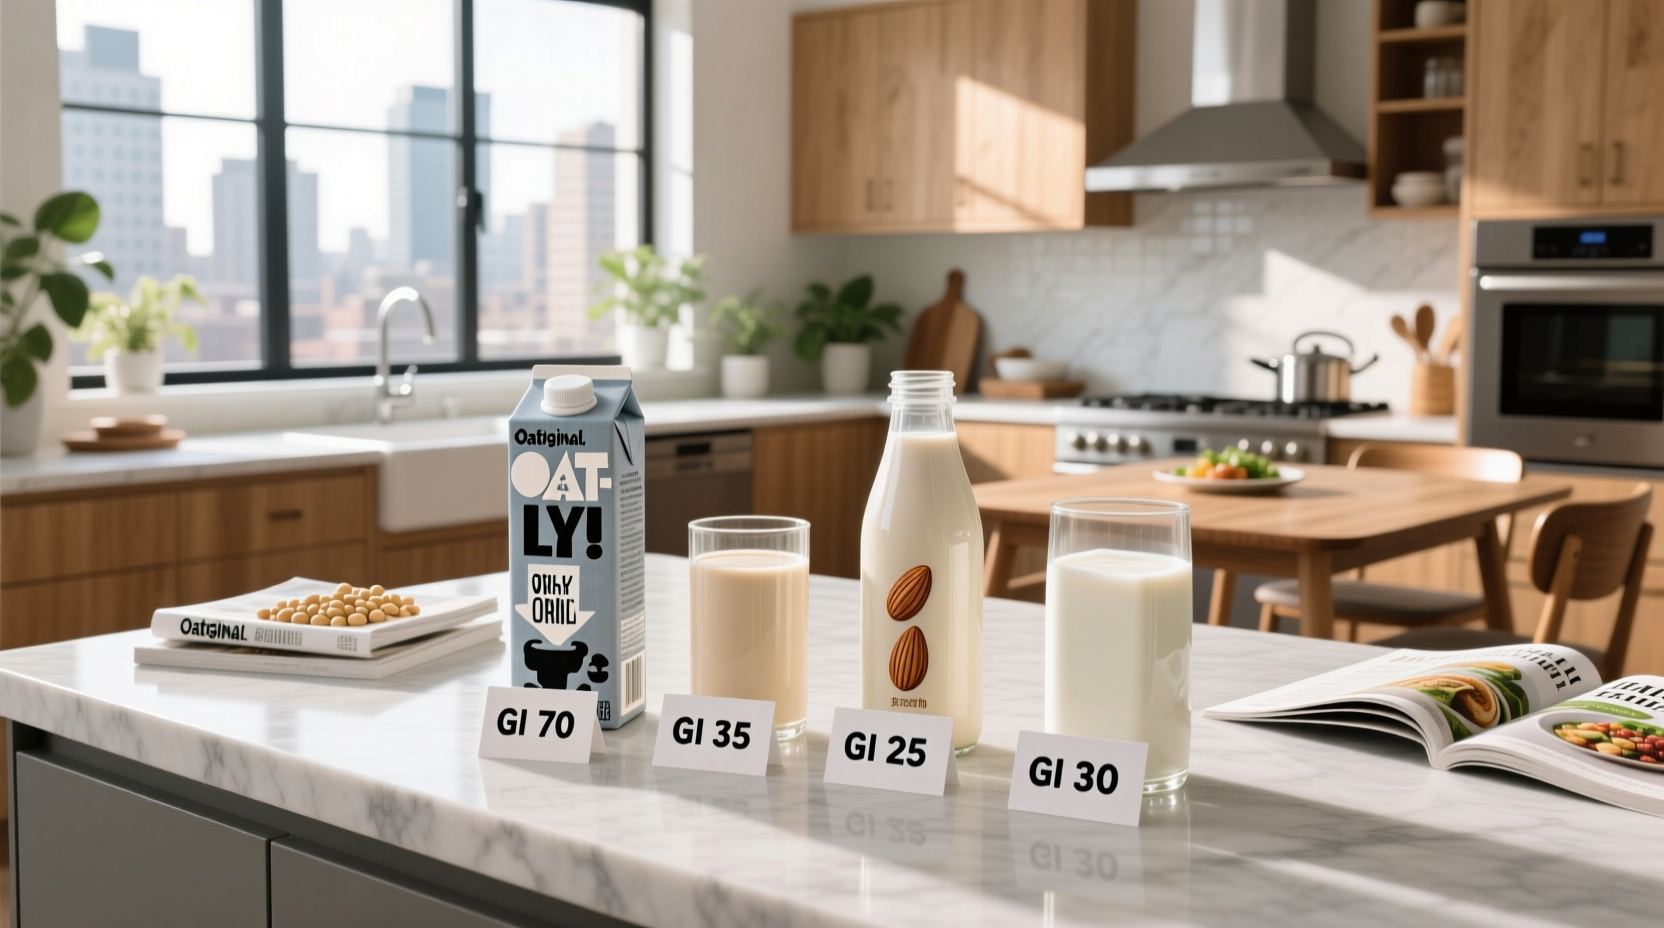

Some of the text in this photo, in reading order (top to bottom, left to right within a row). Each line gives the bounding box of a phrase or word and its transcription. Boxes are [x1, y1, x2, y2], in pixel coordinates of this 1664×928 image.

[523, 504, 603, 561] LY!
[496, 707, 527, 736] GI
[538, 710, 575, 739] 70
[672, 716, 751, 750] GI 35
[844, 731, 927, 768] GI 25
[1029, 756, 1119, 795] GI 30
